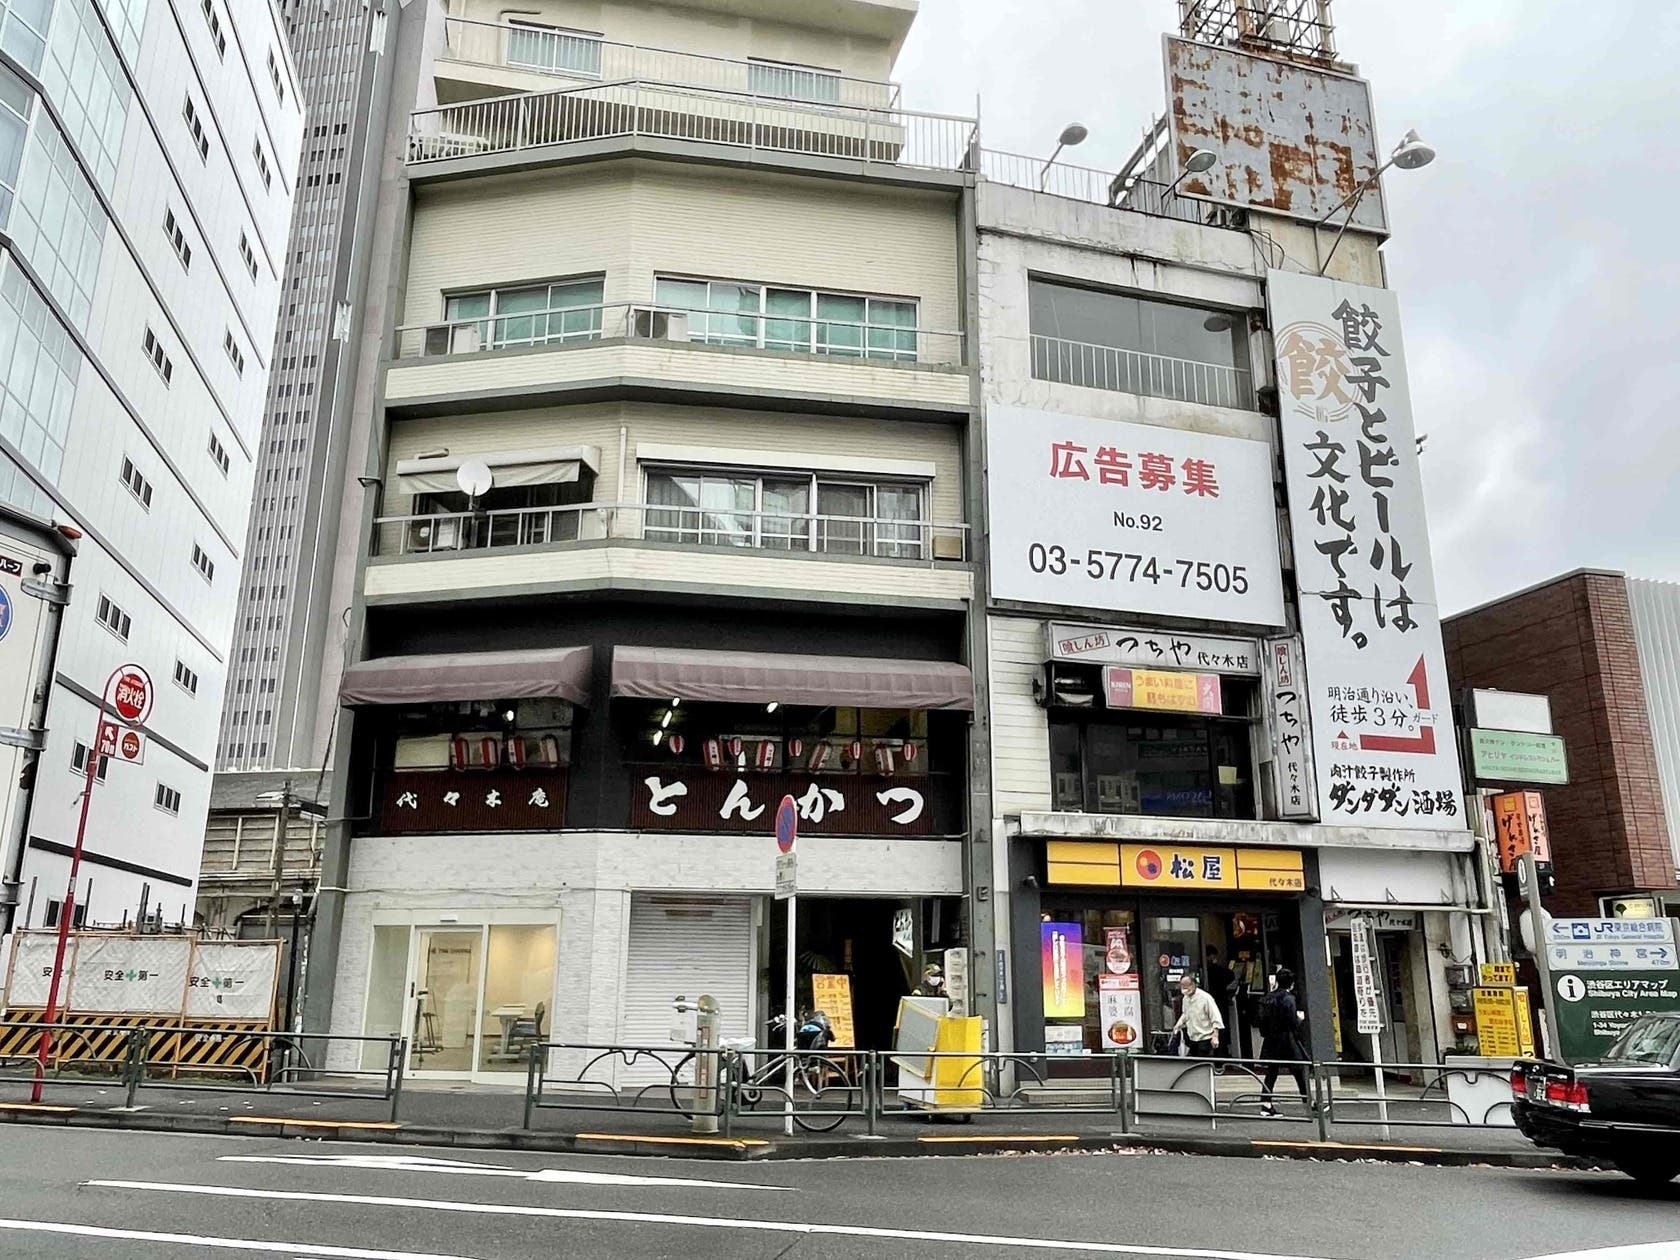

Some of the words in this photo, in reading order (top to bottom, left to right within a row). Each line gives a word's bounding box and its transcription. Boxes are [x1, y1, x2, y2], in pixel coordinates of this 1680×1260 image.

[1050, 441, 1219, 498] 広告募集
[1331, 298, 1419, 633] 餃子とビールは
[1114, 511, 1163, 531] No.92
[1303, 430, 1368, 650] 文化です。
[1028, 542, 1248, 594] 03-5774-7505
[1116, 637, 1191, 665] つちや
[1197, 651, 1249, 669] 代々木店
[117, 684, 145, 709] 消火栓
[1276, 691, 1300, 754] つちや
[396, 787, 549, 809] 代々木庵
[644, 776, 924, 824] とんかつ
[1329, 780, 1458, 816] ダンダダン酒場
[1170, 853, 1222, 880] 松屋
